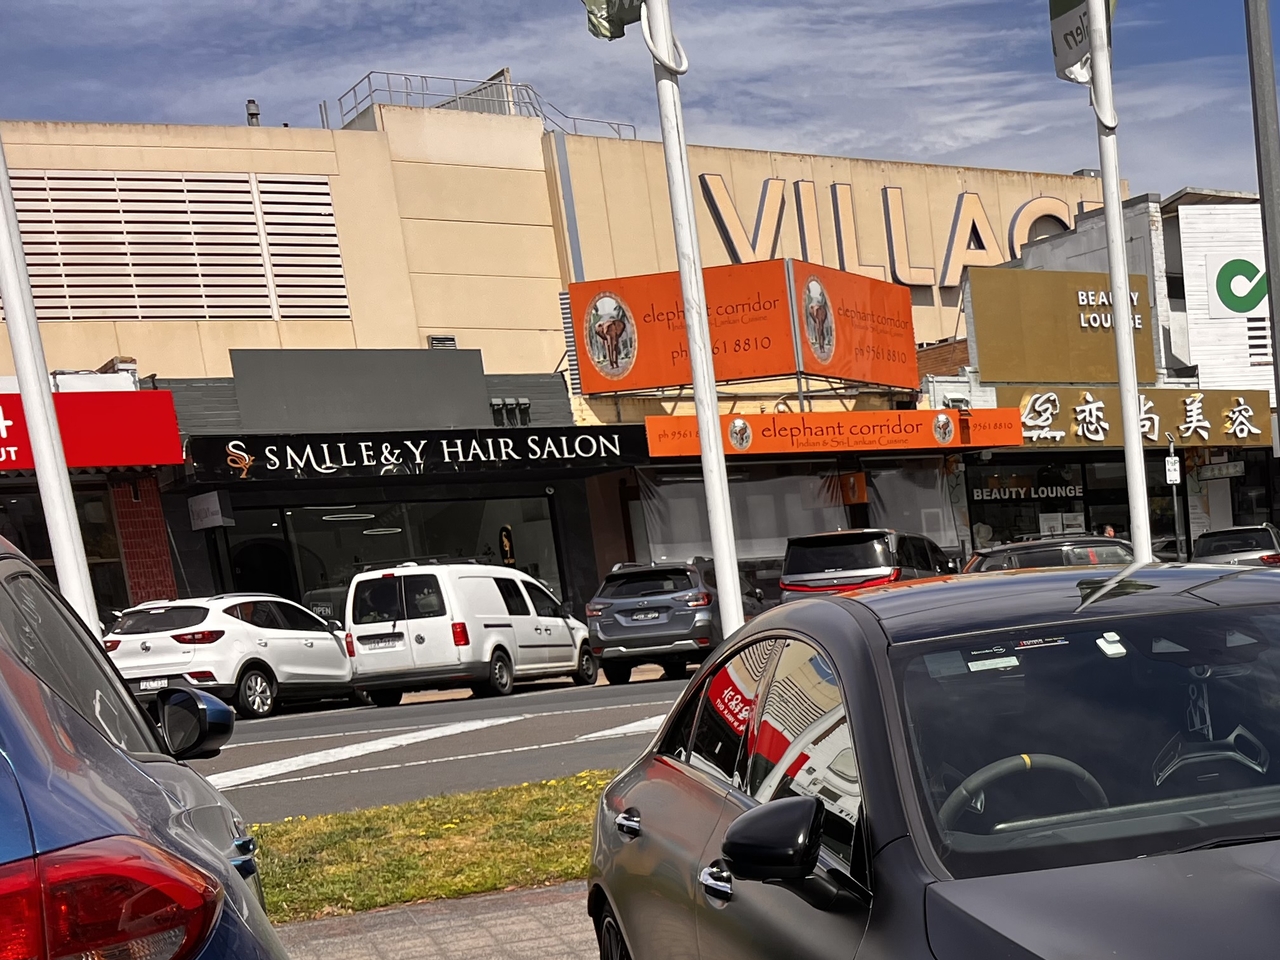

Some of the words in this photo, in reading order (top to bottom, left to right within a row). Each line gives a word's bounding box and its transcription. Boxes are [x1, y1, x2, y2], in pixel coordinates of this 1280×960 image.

[698, 173, 1104, 288] VILLAG
[1078, 291, 1139, 306] BEAY
[643, 301, 711, 330] elepht
[716, 291, 779, 316] corridor
[837, 298, 875, 326] elephant
[877, 311, 910, 330] corridor
[1080, 313, 1142, 329] LOUE
[671, 342, 688, 366] ph
[711, 339, 728, 356] 61
[733, 336, 772, 353] 8810
[855, 341, 865, 362] ph
[866, 345, 885, 361] 9561
[887, 349, 907, 364] 8810
[972, 422, 991, 431] 9561
[993, 422, 1013, 430] 8810
[1075, 391, 1262, 442] 恋尚美容
[658, 430, 669, 442] ph
[671, 430, 692, 440] 9561
[761, 417, 845, 447] elephant
[850, 418, 923, 436] corridor
[796, 437, 820, 448] Indian
[830, 437, 877, 448] Sri-Lankan
[877, 435, 909, 446] Cuisine
[265, 440, 428, 474] SMILE&Y
[440, 438, 521, 463] HAIR
[528, 434, 621, 460] SALON
[973, 487, 1026, 500] BEAUTY
[1030, 485, 1083, 498] LOUNGE
[312, 606, 331, 615] OPEN
